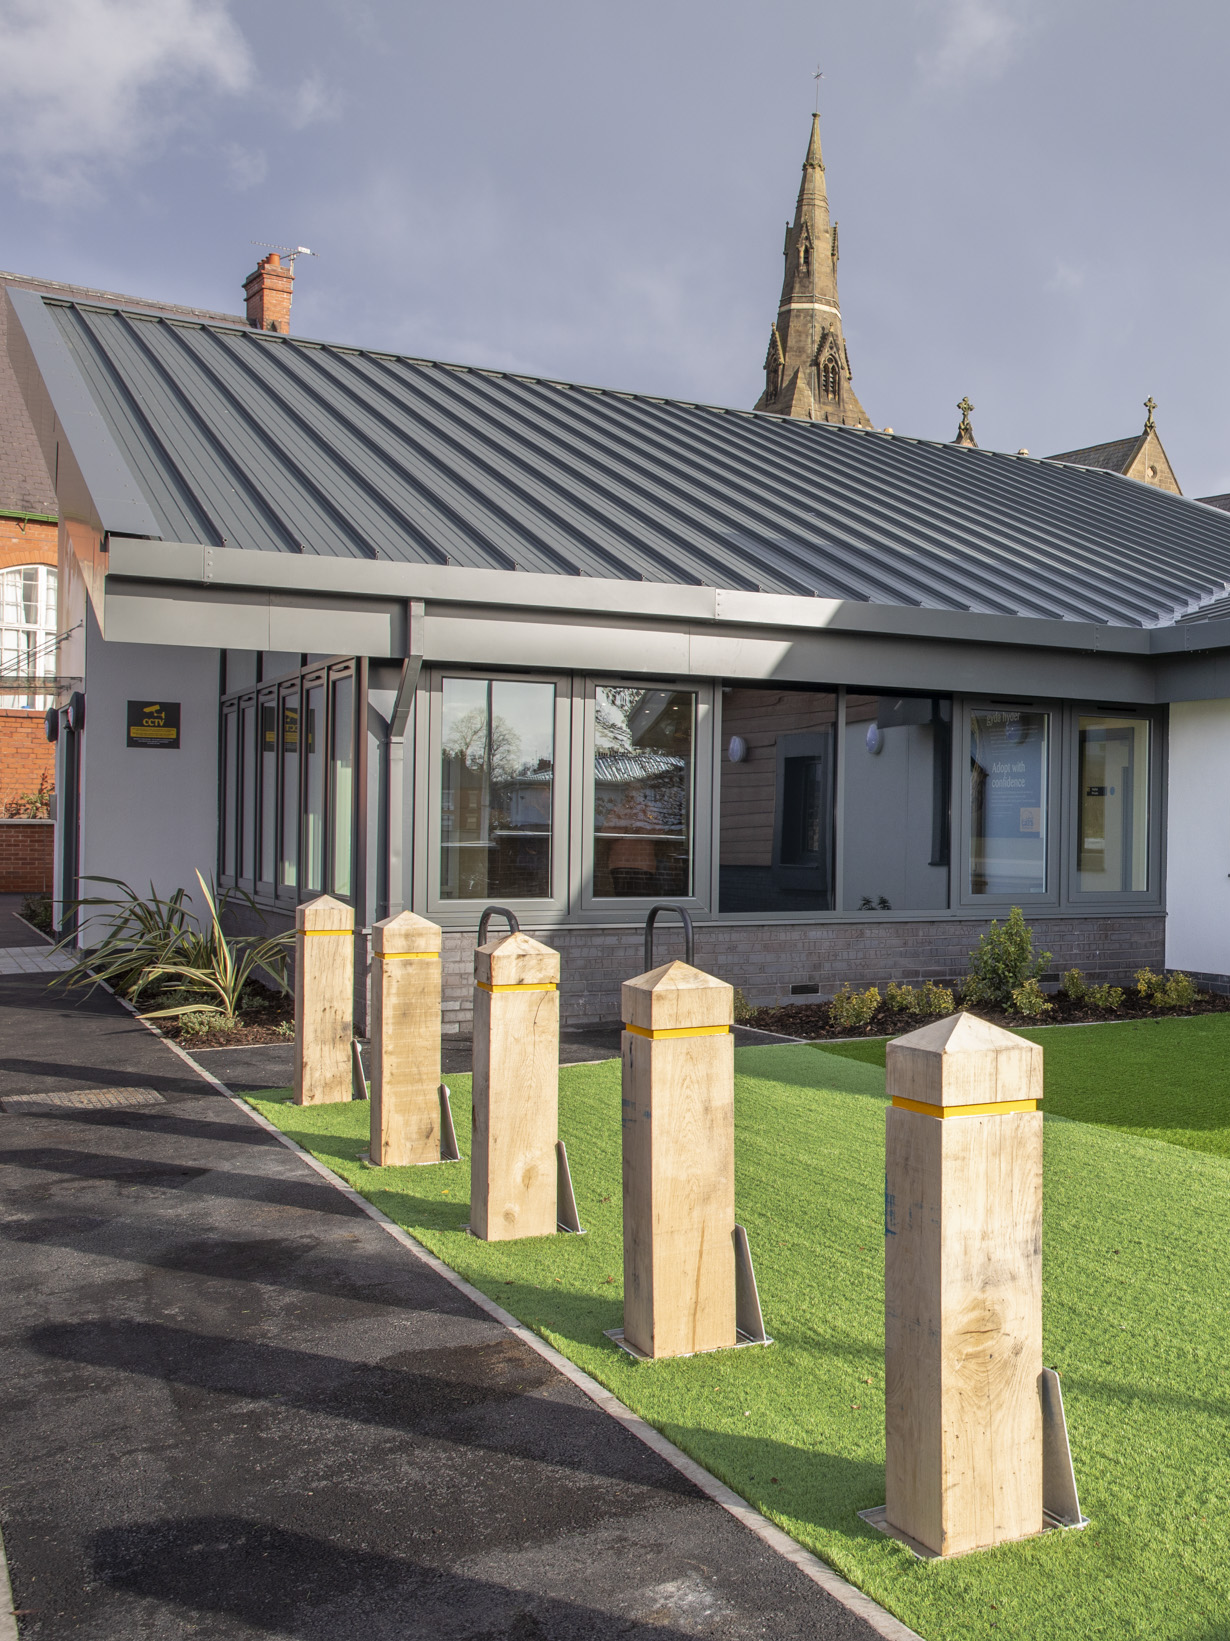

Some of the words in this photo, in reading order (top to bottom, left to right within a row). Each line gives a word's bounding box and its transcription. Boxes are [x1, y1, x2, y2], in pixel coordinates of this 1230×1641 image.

[142, 718, 165, 726] CCTV
[992, 762, 1010, 777] Adopt
[1011, 761, 1025, 773] with
[992, 777, 1026, 788] confidence
